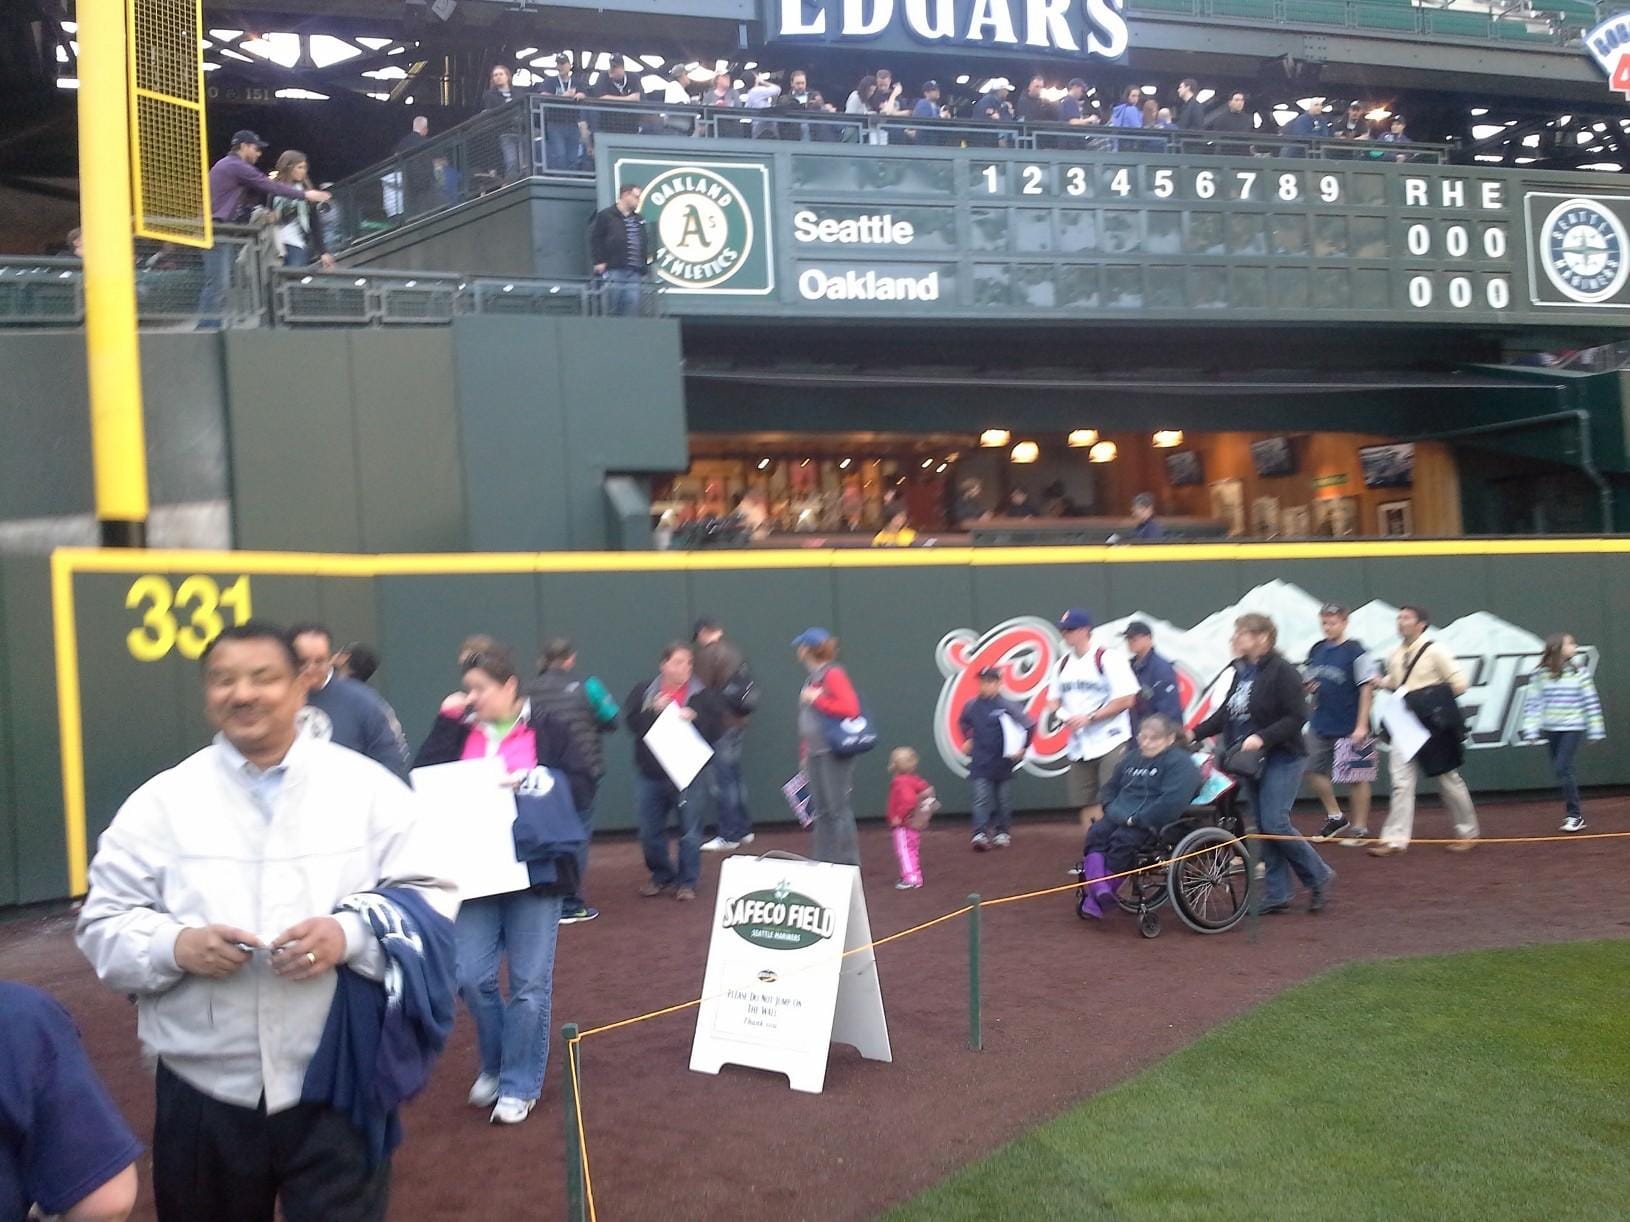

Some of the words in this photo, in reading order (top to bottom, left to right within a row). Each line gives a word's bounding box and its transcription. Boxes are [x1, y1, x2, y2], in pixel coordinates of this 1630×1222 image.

[651, 176, 733, 207] OAKLAND
[982, 165, 997, 194] 1
[1022, 165, 1043, 195] 2
[1066, 166, 1087, 196] 3
[1110, 168, 1131, 197] 4
[1154, 169, 1174, 198] 5
[1195, 171, 1216, 198] 6
[1237, 172, 1256, 200] 7
[1278, 173, 1298, 201] 8
[1319, 175, 1339, 203] 9
[1405, 178, 1429, 206] R
[1442, 180, 1464, 208] H
[1482, 181, 1503, 209] E
[793, 210, 914, 244] Seattle
[1408, 224, 1430, 256] 0
[1446, 225, 1468, 257] 0
[1483, 227, 1506, 258] 0
[656, 247, 738, 280] ATHLETICS
[798, 268, 939, 301] Oakland
[1409, 276, 1432, 308] 0
[1449, 277, 1472, 308] 0
[1486, 278, 1509, 309] 0
[126, 575, 253, 662] 331
[722, 897, 788, 929] SAFECO
[787, 904, 836, 940] FIELD
[751, 928, 774, 939] SEATTLE
